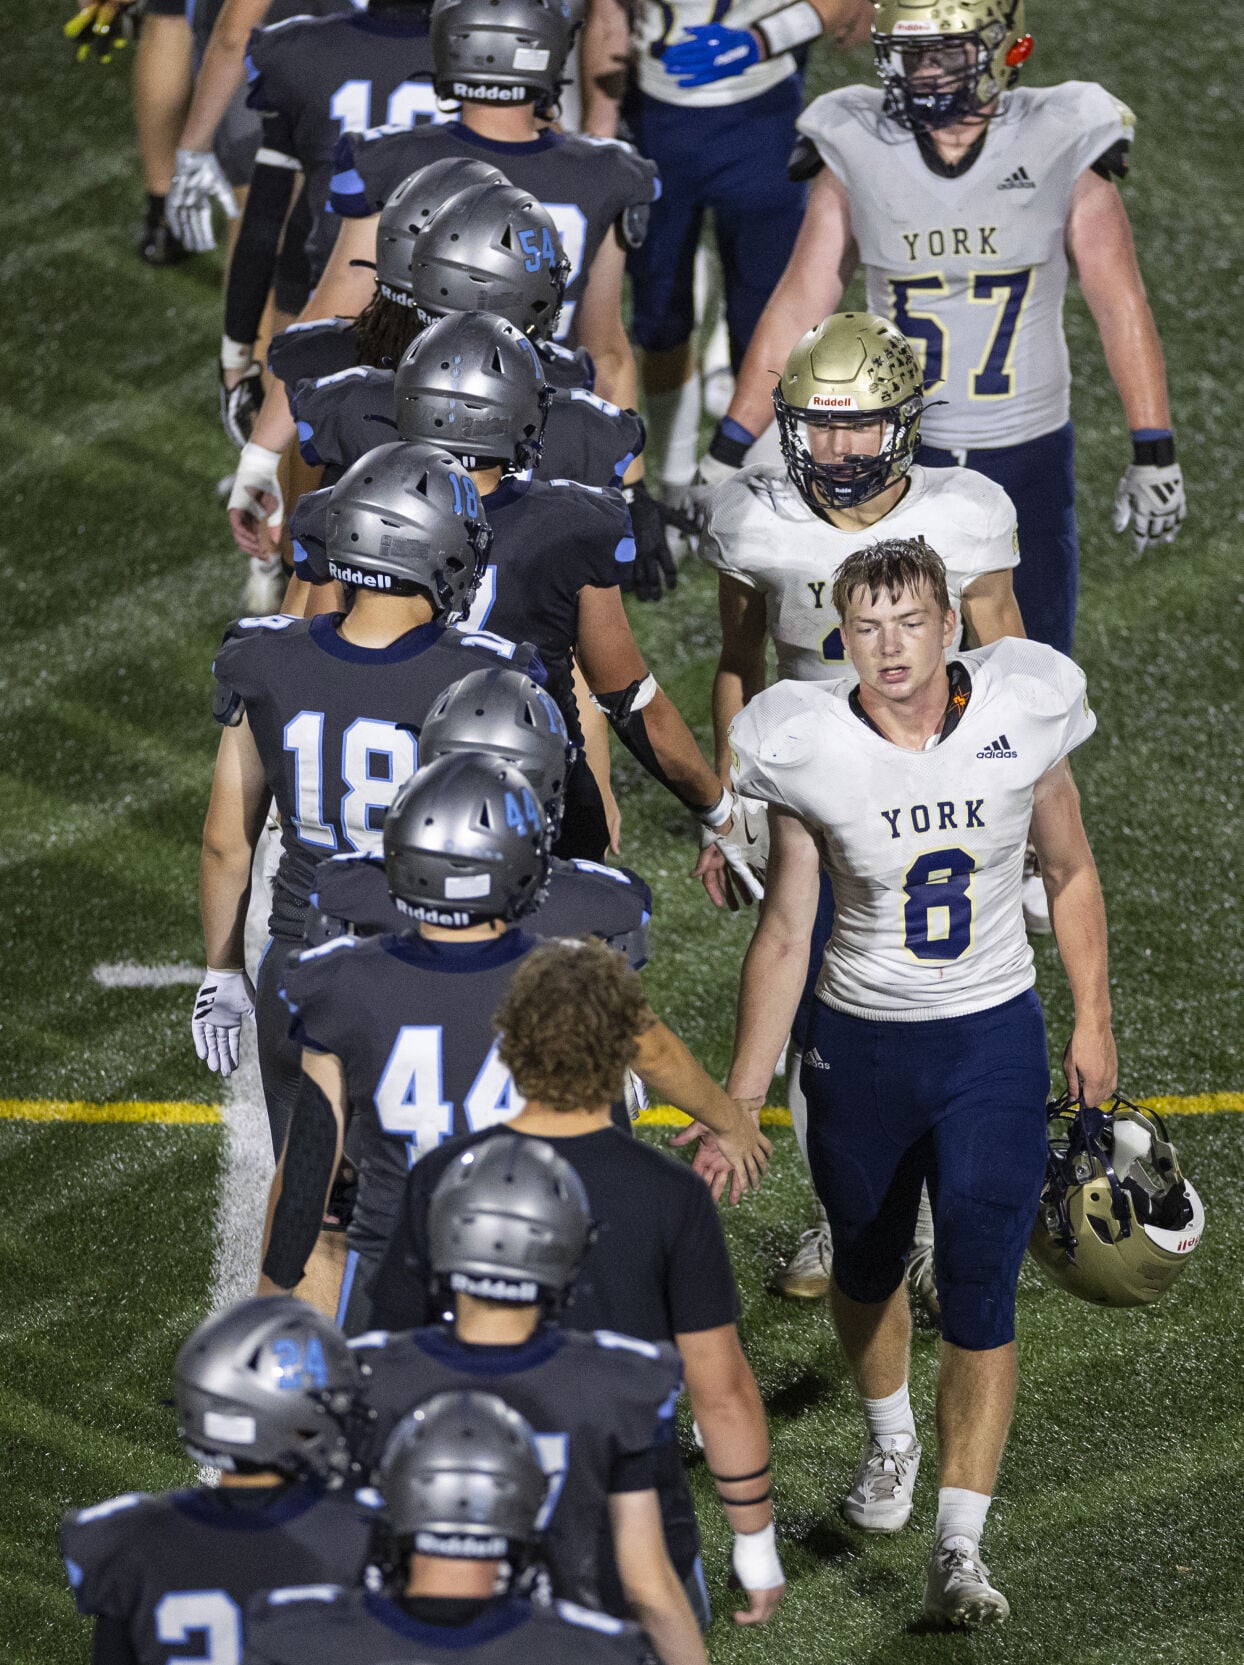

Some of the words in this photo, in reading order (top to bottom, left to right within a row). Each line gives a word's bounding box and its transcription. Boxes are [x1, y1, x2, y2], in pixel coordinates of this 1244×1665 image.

[453, 82, 526, 101] Riddell
[517, 228, 556, 273] 54
[902, 226, 998, 262] YORK
[884, 268, 1036, 400] 57
[813, 396, 851, 407] Riddell
[448, 471, 478, 519] 18
[328, 561, 391, 589] Riddell
[976, 750, 1018, 759] adidas
[283, 710, 418, 852] 18
[504, 787, 541, 837] 44
[880, 798, 986, 840] YORK
[396, 898, 469, 926] Riddell
[902, 846, 977, 962] 8
[373, 1024, 528, 1170] 44
[450, 1272, 538, 1302] Riddell
[415, 1532, 508, 1557] Riddell
